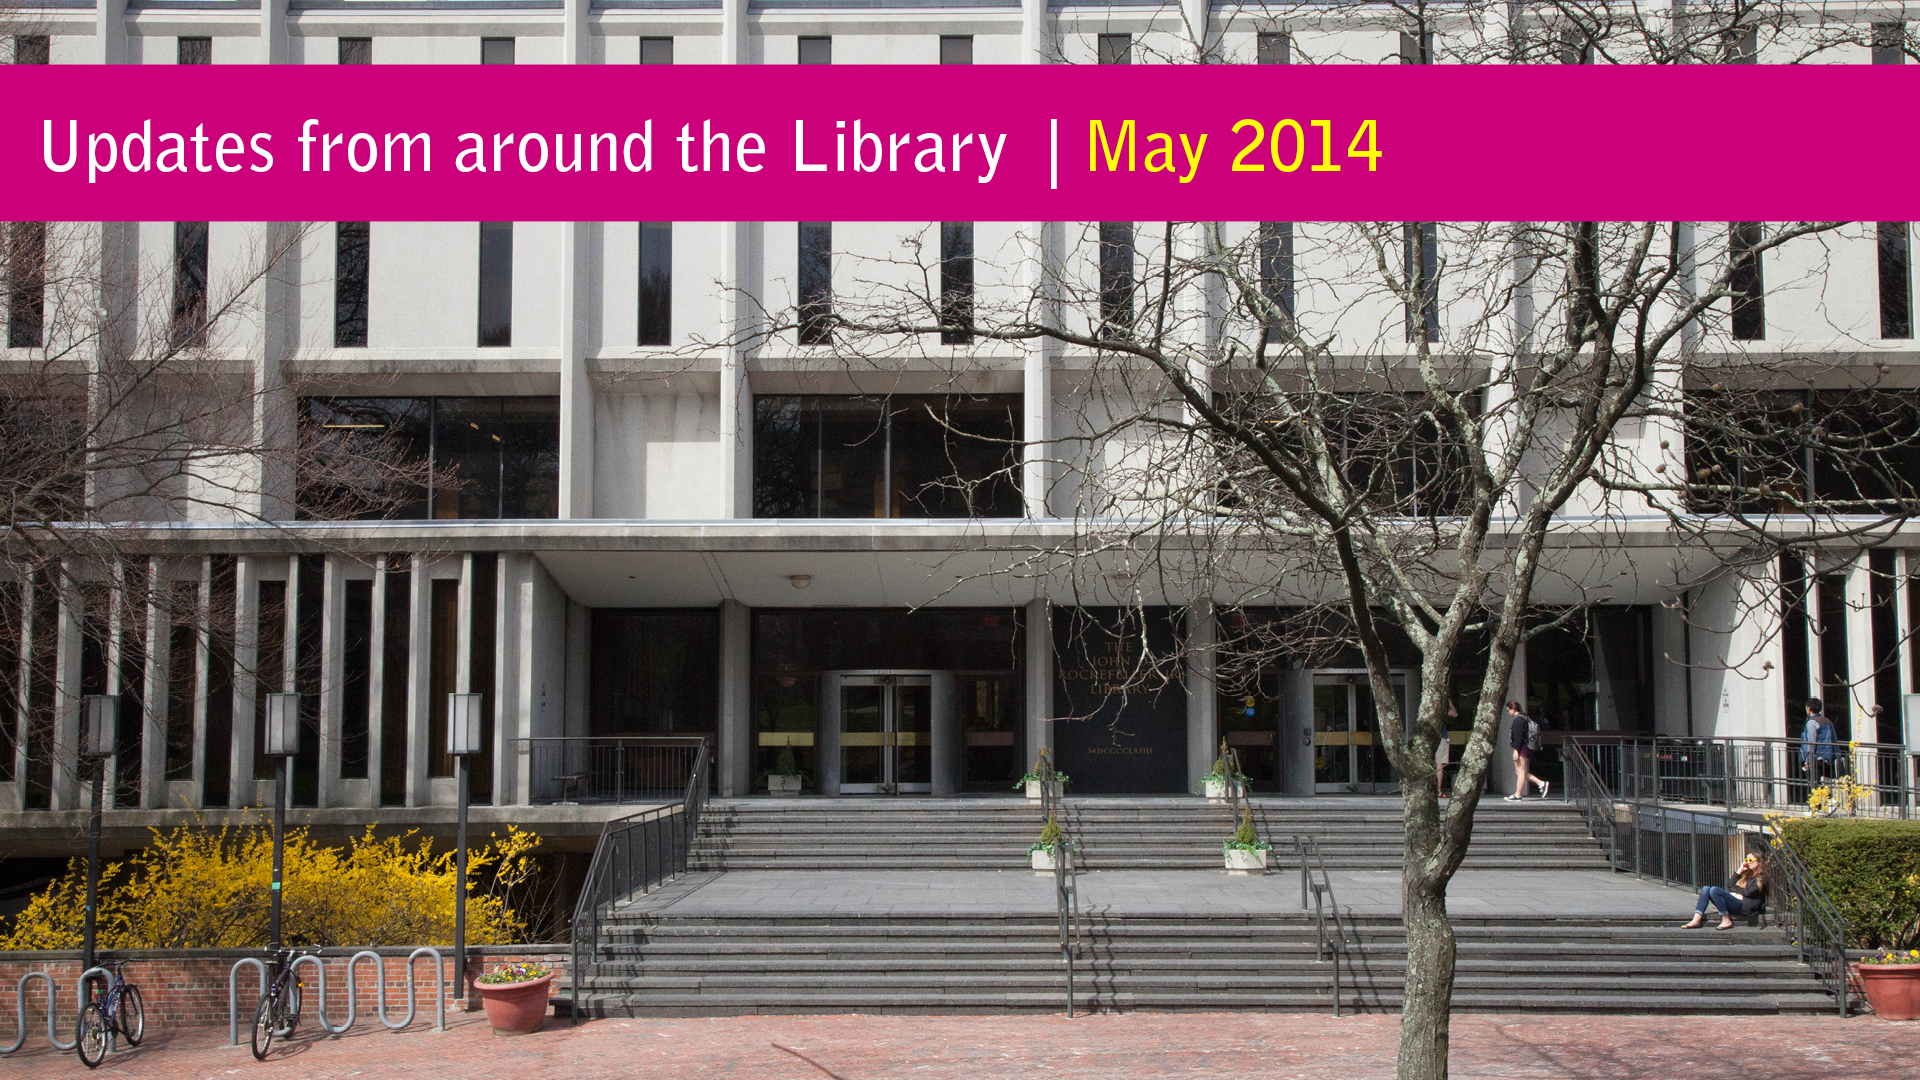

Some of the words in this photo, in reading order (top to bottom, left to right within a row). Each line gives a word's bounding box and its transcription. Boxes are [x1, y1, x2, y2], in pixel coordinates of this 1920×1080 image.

[1105, 641, 1132, 652] THE
[1093, 656, 1130, 667] JOHN
[1091, 684, 1150, 694] LIBRARY
